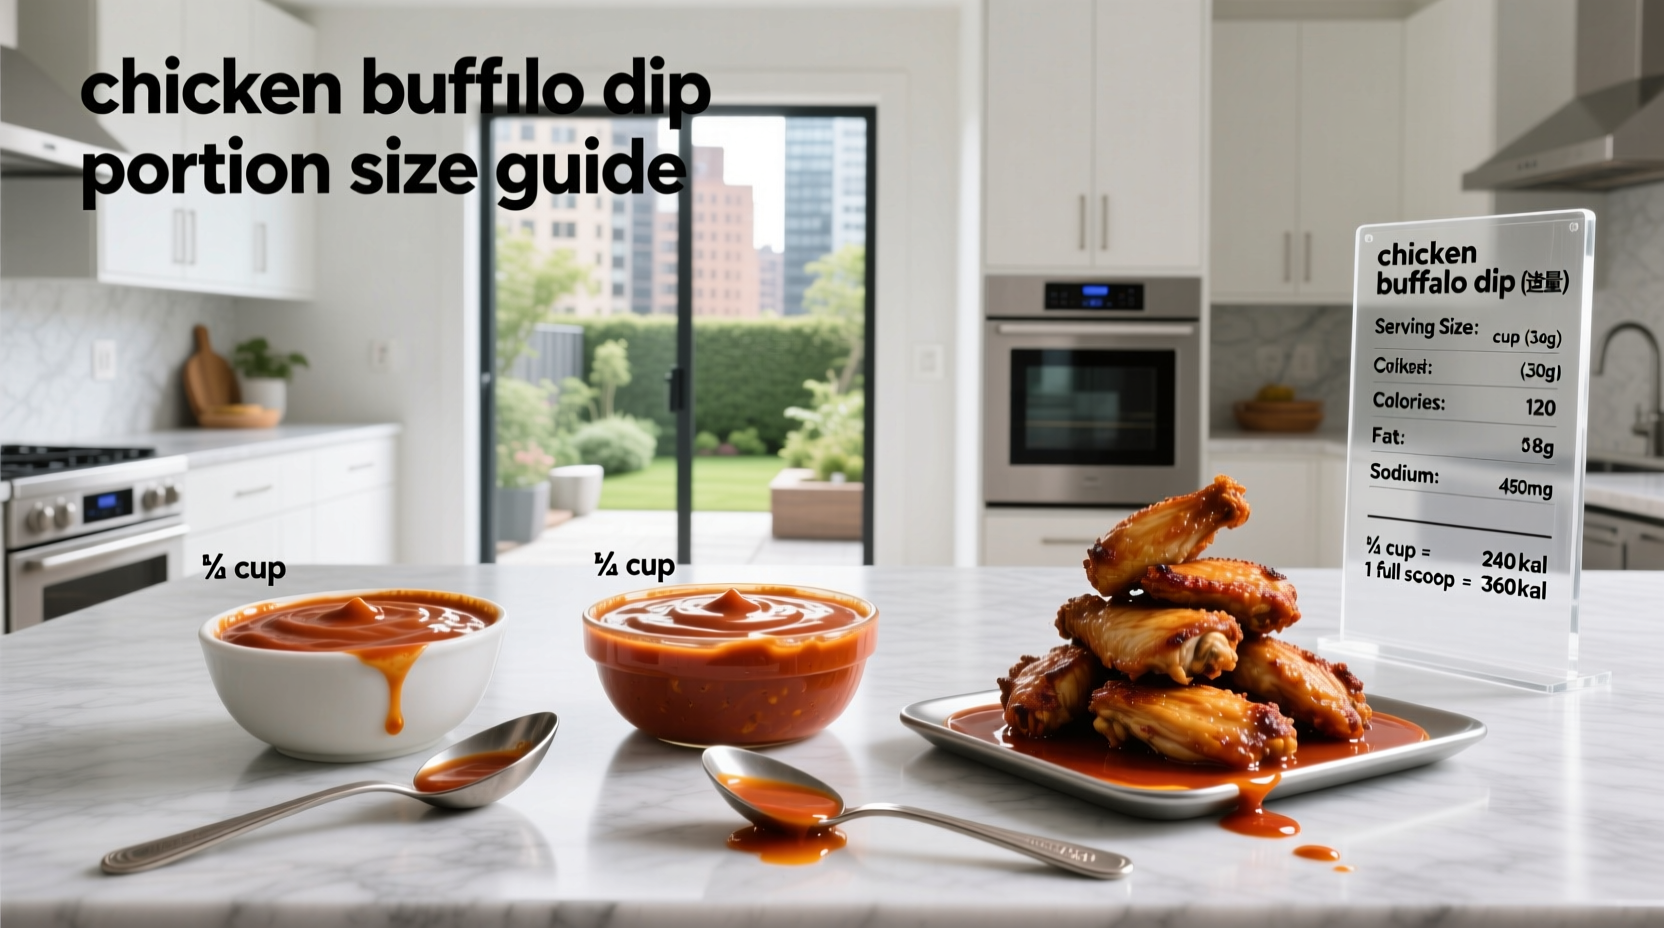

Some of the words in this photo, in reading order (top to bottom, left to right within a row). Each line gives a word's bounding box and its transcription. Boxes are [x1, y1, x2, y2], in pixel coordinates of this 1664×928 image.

[1377, 241, 1477, 266] chicken
[1376, 269, 1467, 296] buffalo
[1473, 267, 1516, 300] dip
[1374, 316, 1435, 340] Serving
[1438, 317, 1479, 336] Size:
[1492, 332, 1521, 348] cup
[1520, 361, 1562, 383] (30g)
[1525, 397, 1557, 417] 120
[1372, 426, 1405, 446] Fat:
[1370, 462, 1439, 484] Sodium:
[1498, 477, 1553, 501] 450mg
[1385, 542, 1417, 561] cup
[1364, 561, 1372, 577] 1
[1376, 560, 1401, 580] full
[1404, 569, 1455, 592] scoop
